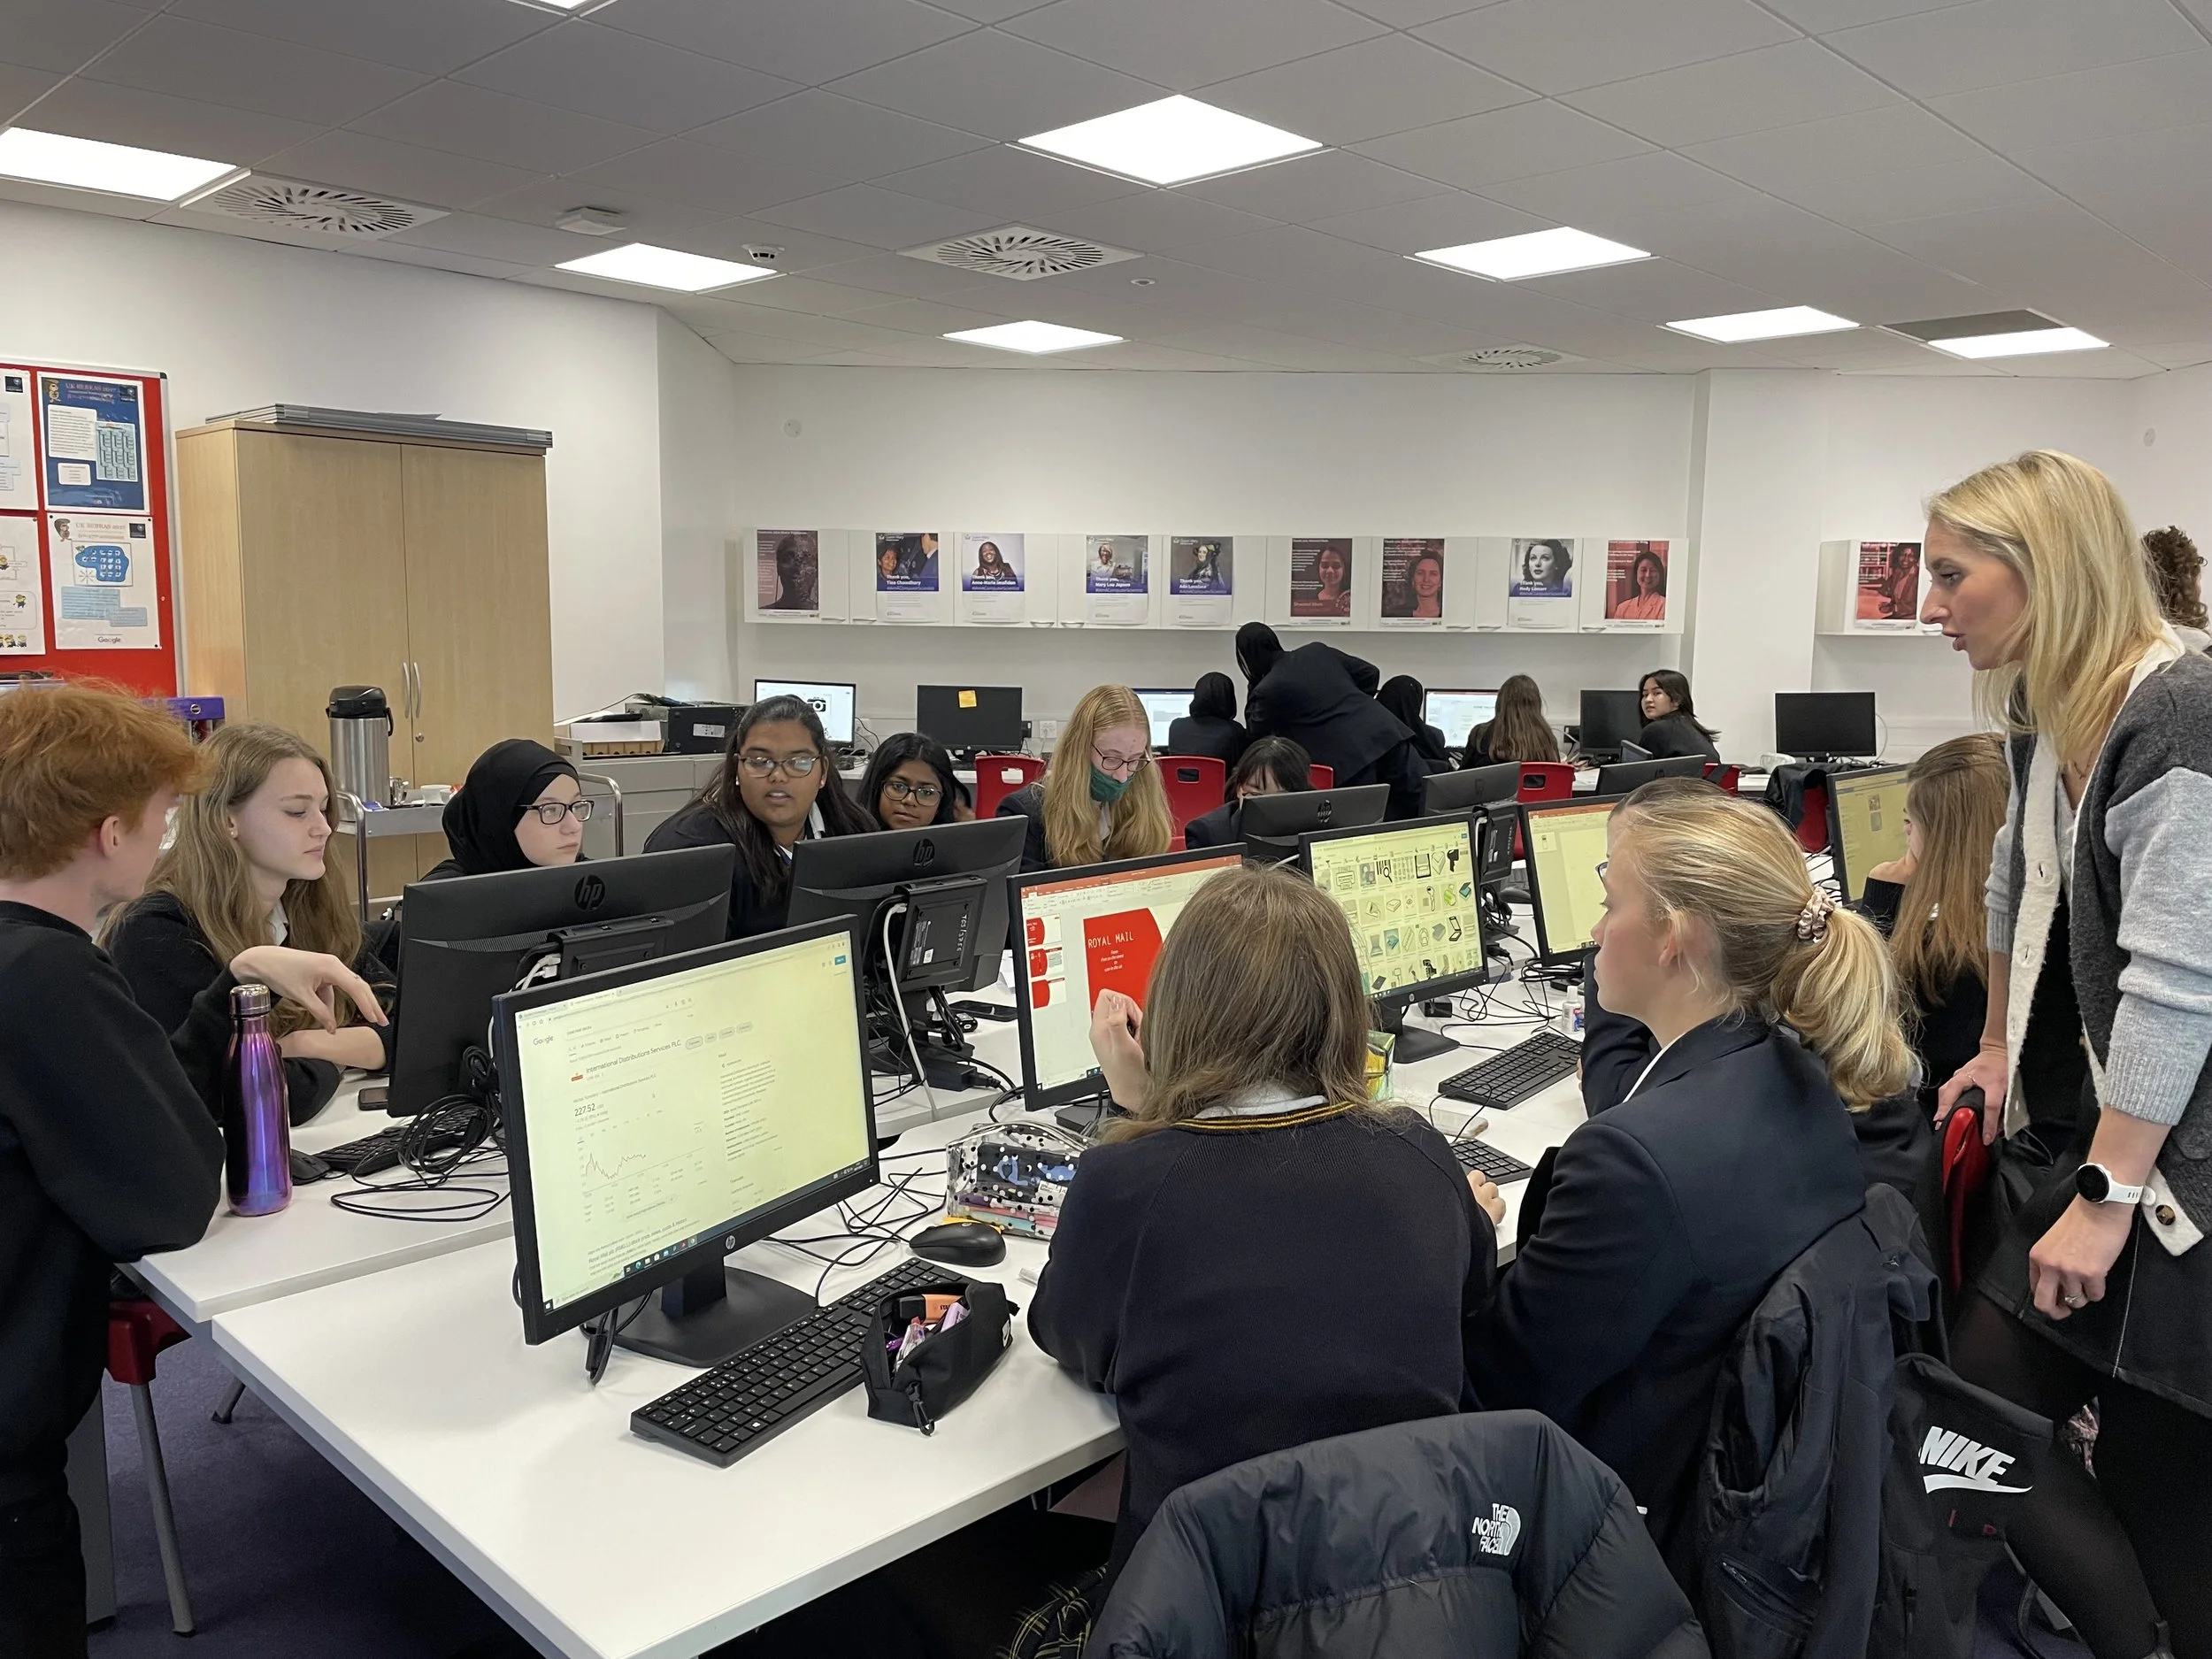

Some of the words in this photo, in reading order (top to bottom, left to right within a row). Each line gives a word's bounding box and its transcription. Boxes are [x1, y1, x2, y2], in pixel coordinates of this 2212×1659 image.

[1087, 935, 1111, 949] ROYAL
[1115, 931, 1134, 943] MAIL
[586, 1057, 618, 1074] International
[619, 1050, 650, 1064] Distributions
[650, 1044, 671, 1054] Services
[574, 1102, 595, 1117] 227.52
[1918, 1425, 2016, 1486] NIKE
[1492, 1503, 1509, 1521] THE
[1471, 1517, 1502, 1537] NORTH
[1479, 1535, 1502, 1555] FACE
